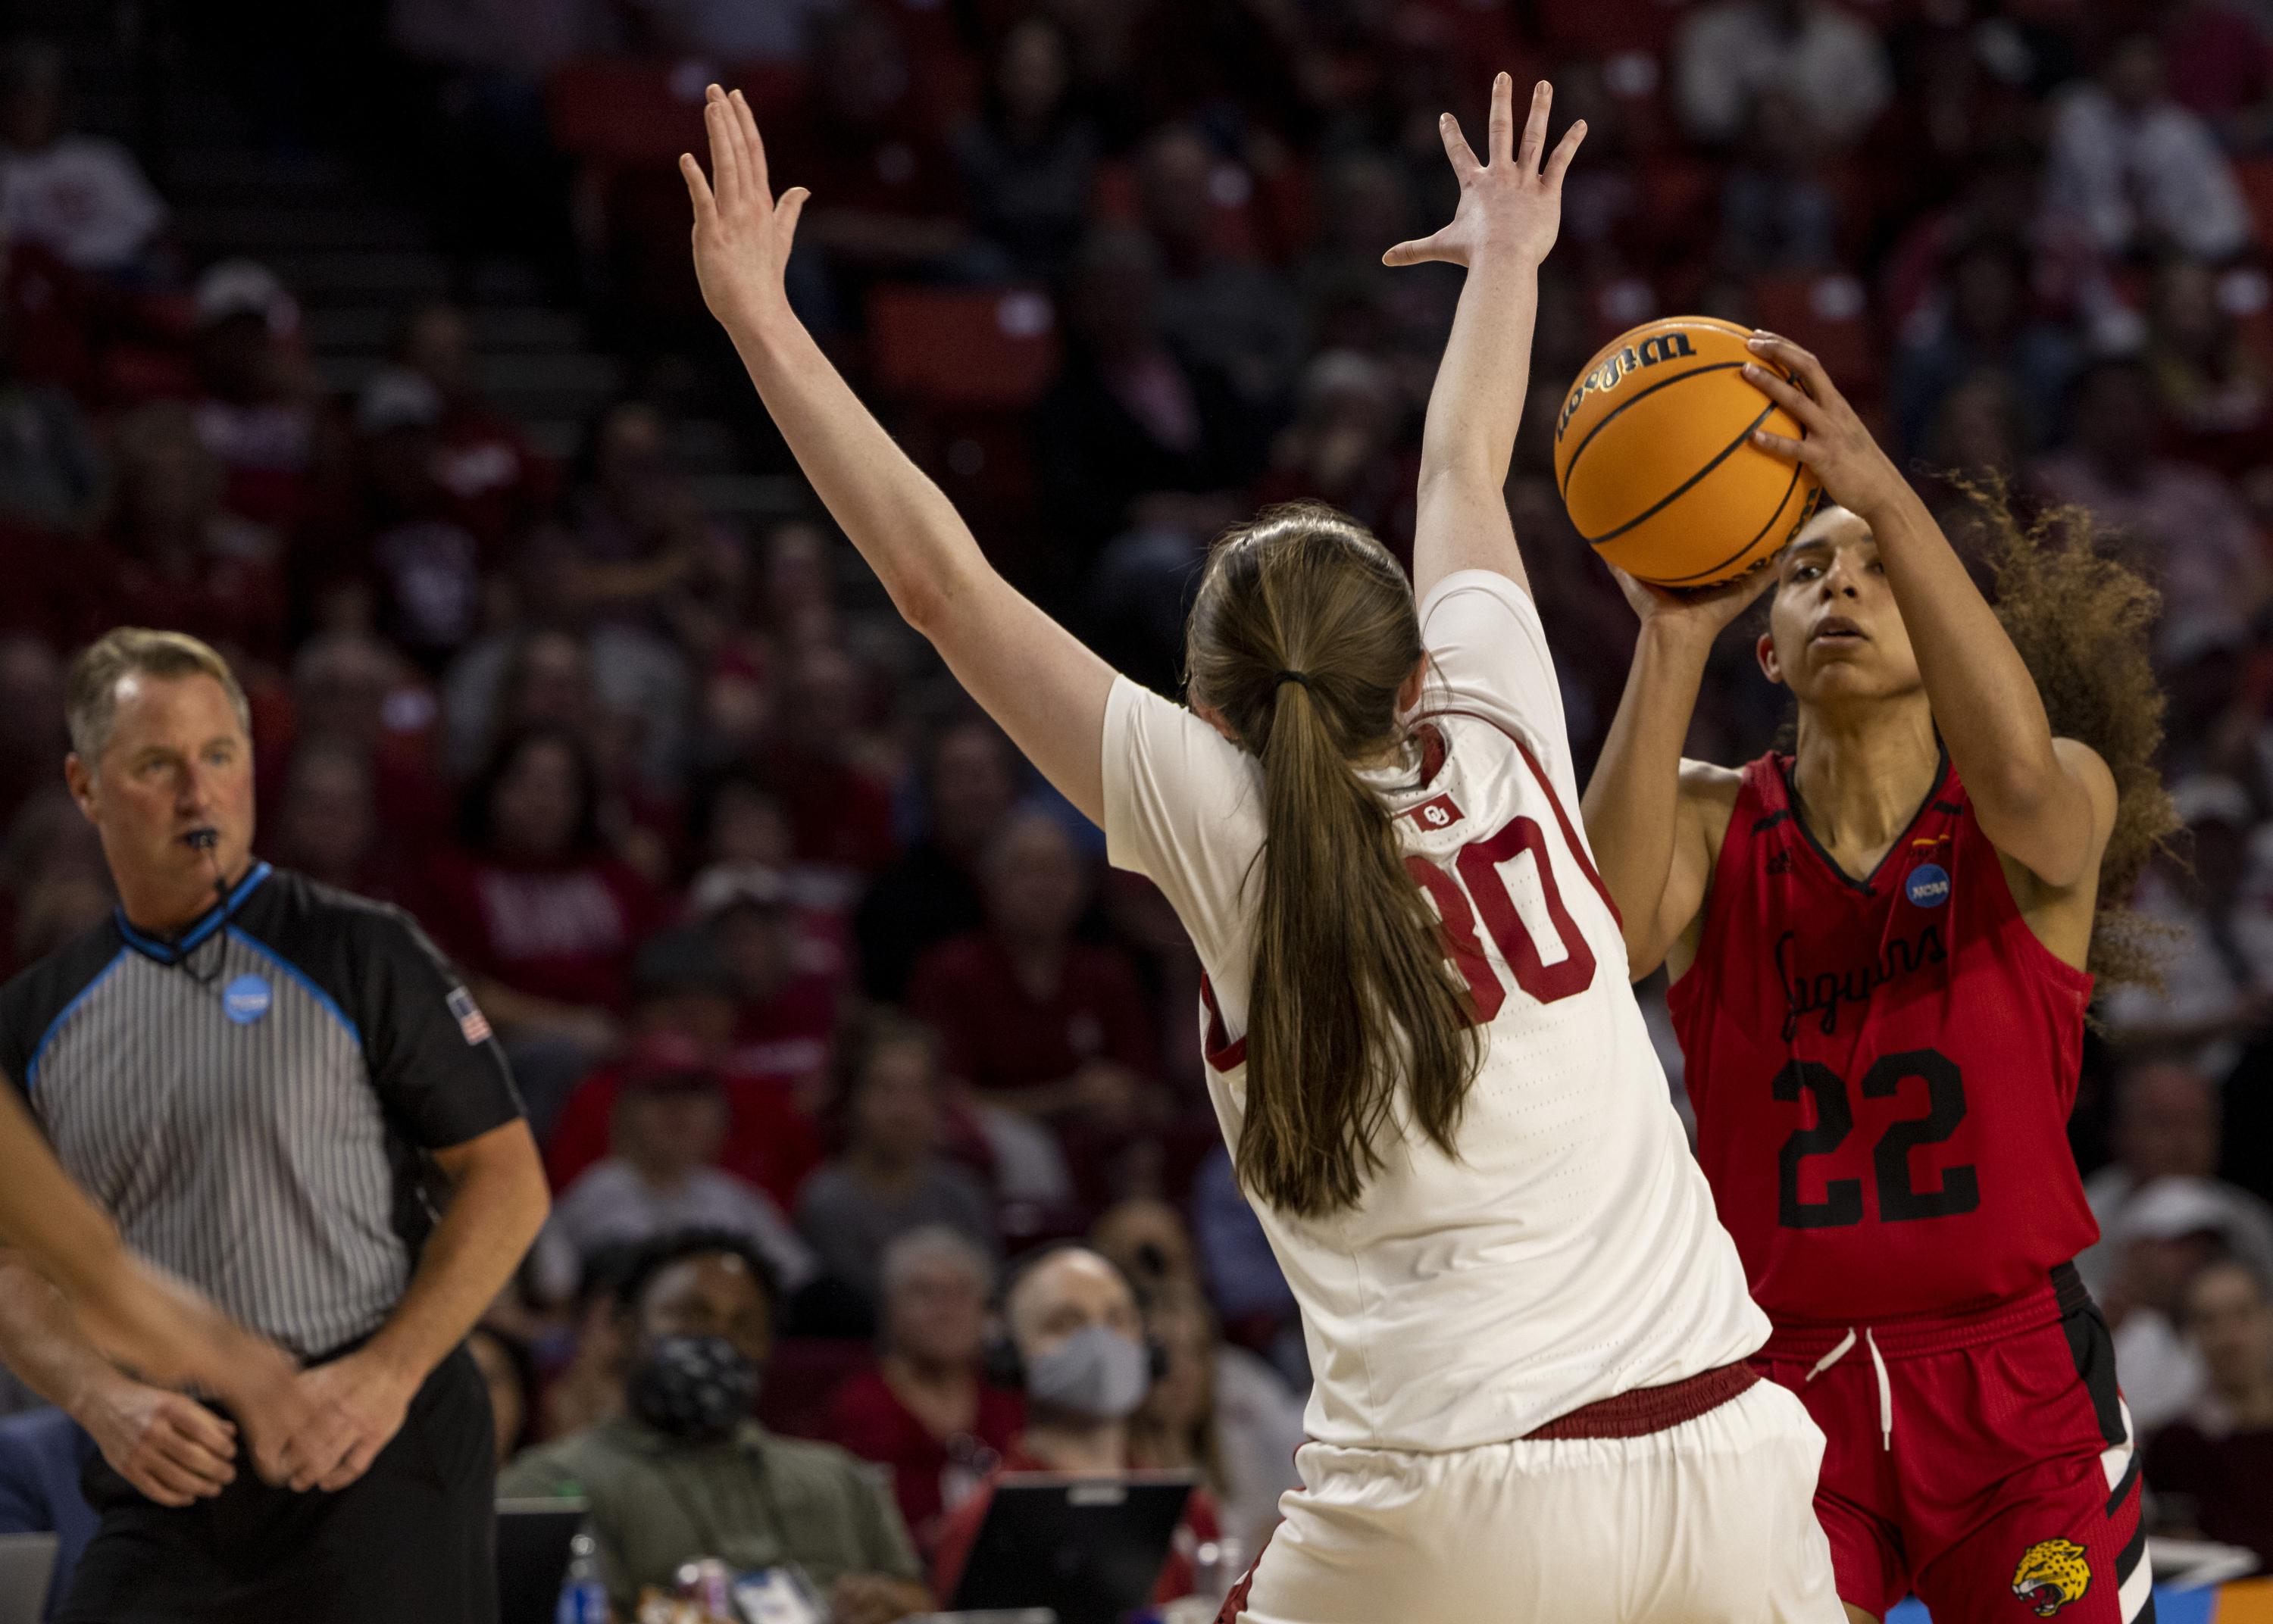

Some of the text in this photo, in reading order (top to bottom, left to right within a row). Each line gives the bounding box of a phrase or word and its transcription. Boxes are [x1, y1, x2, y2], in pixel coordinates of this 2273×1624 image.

[1558, 332, 1697, 443] Wilson
[1775, 926, 1946, 1042] Jgurs
[1772, 1048, 1980, 1229] 22
